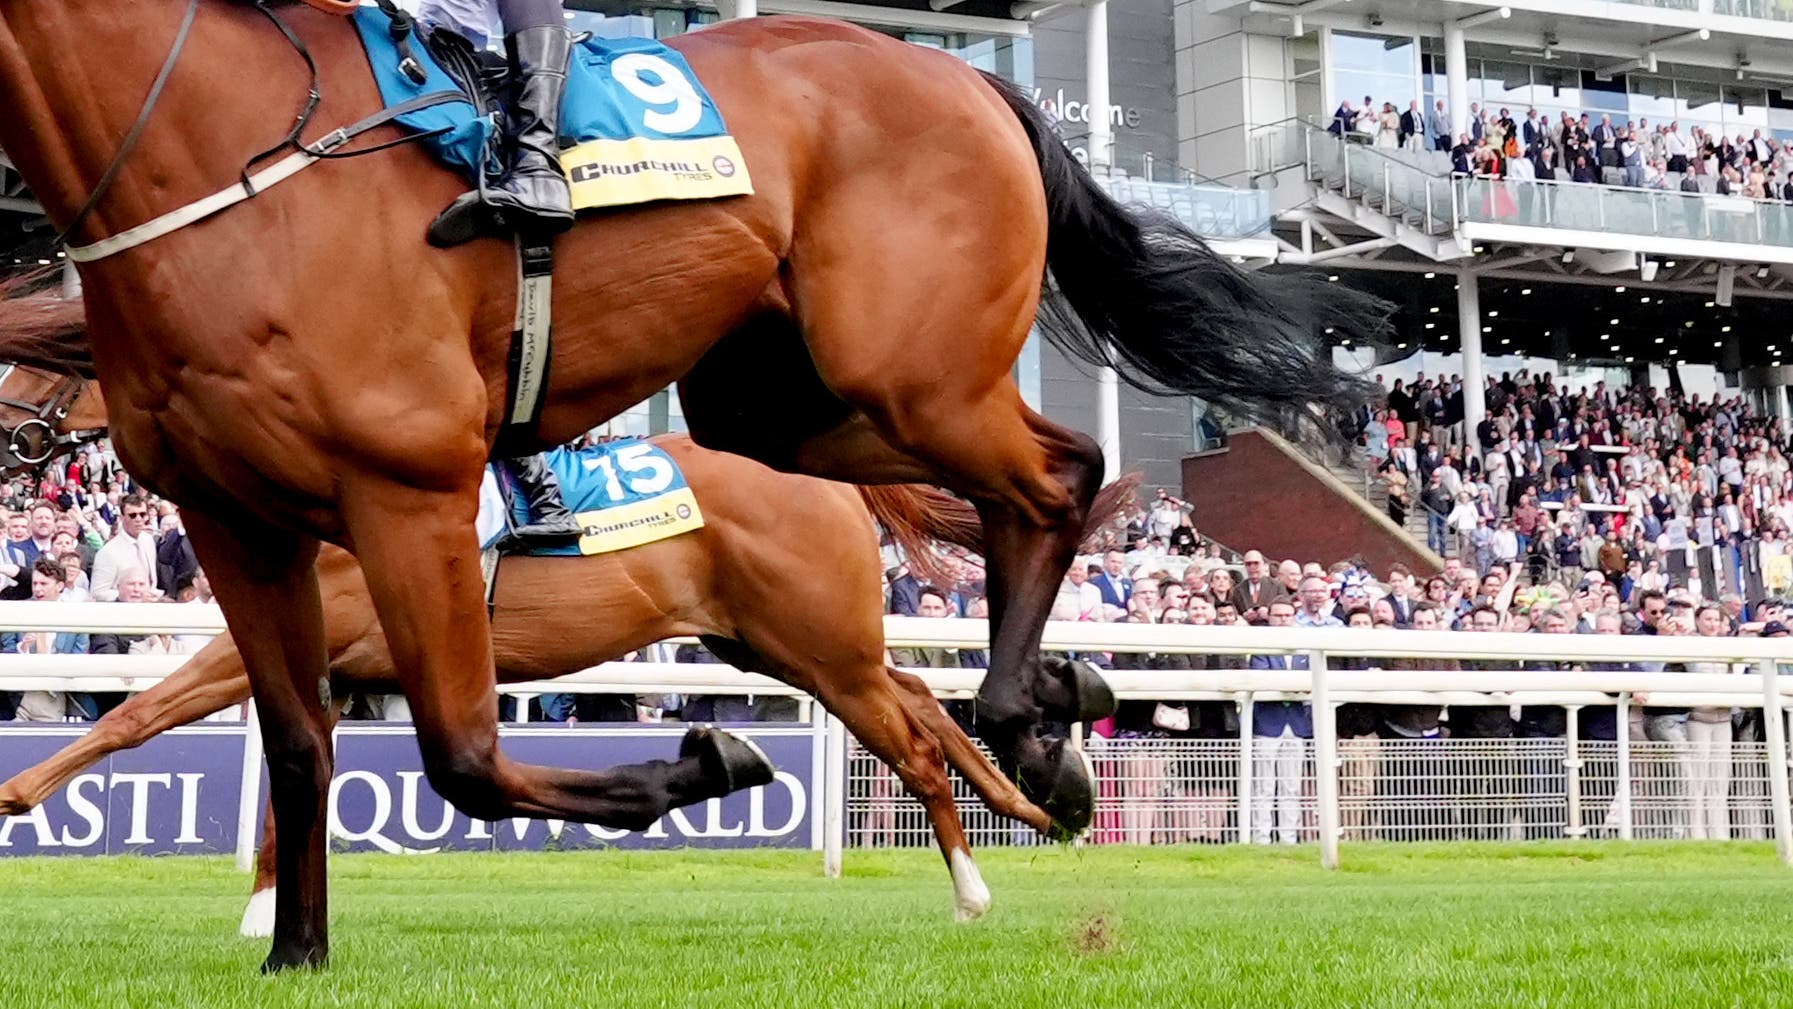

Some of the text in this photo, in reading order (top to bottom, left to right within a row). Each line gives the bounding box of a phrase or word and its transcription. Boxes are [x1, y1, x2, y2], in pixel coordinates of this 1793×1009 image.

[610, 53, 703, 134] 9
[571, 160, 708, 183] CHURCHILL
[674, 172, 713, 181] TYRES
[582, 443, 674, 501] 15
[584, 511, 673, 537] CHURCHILL
